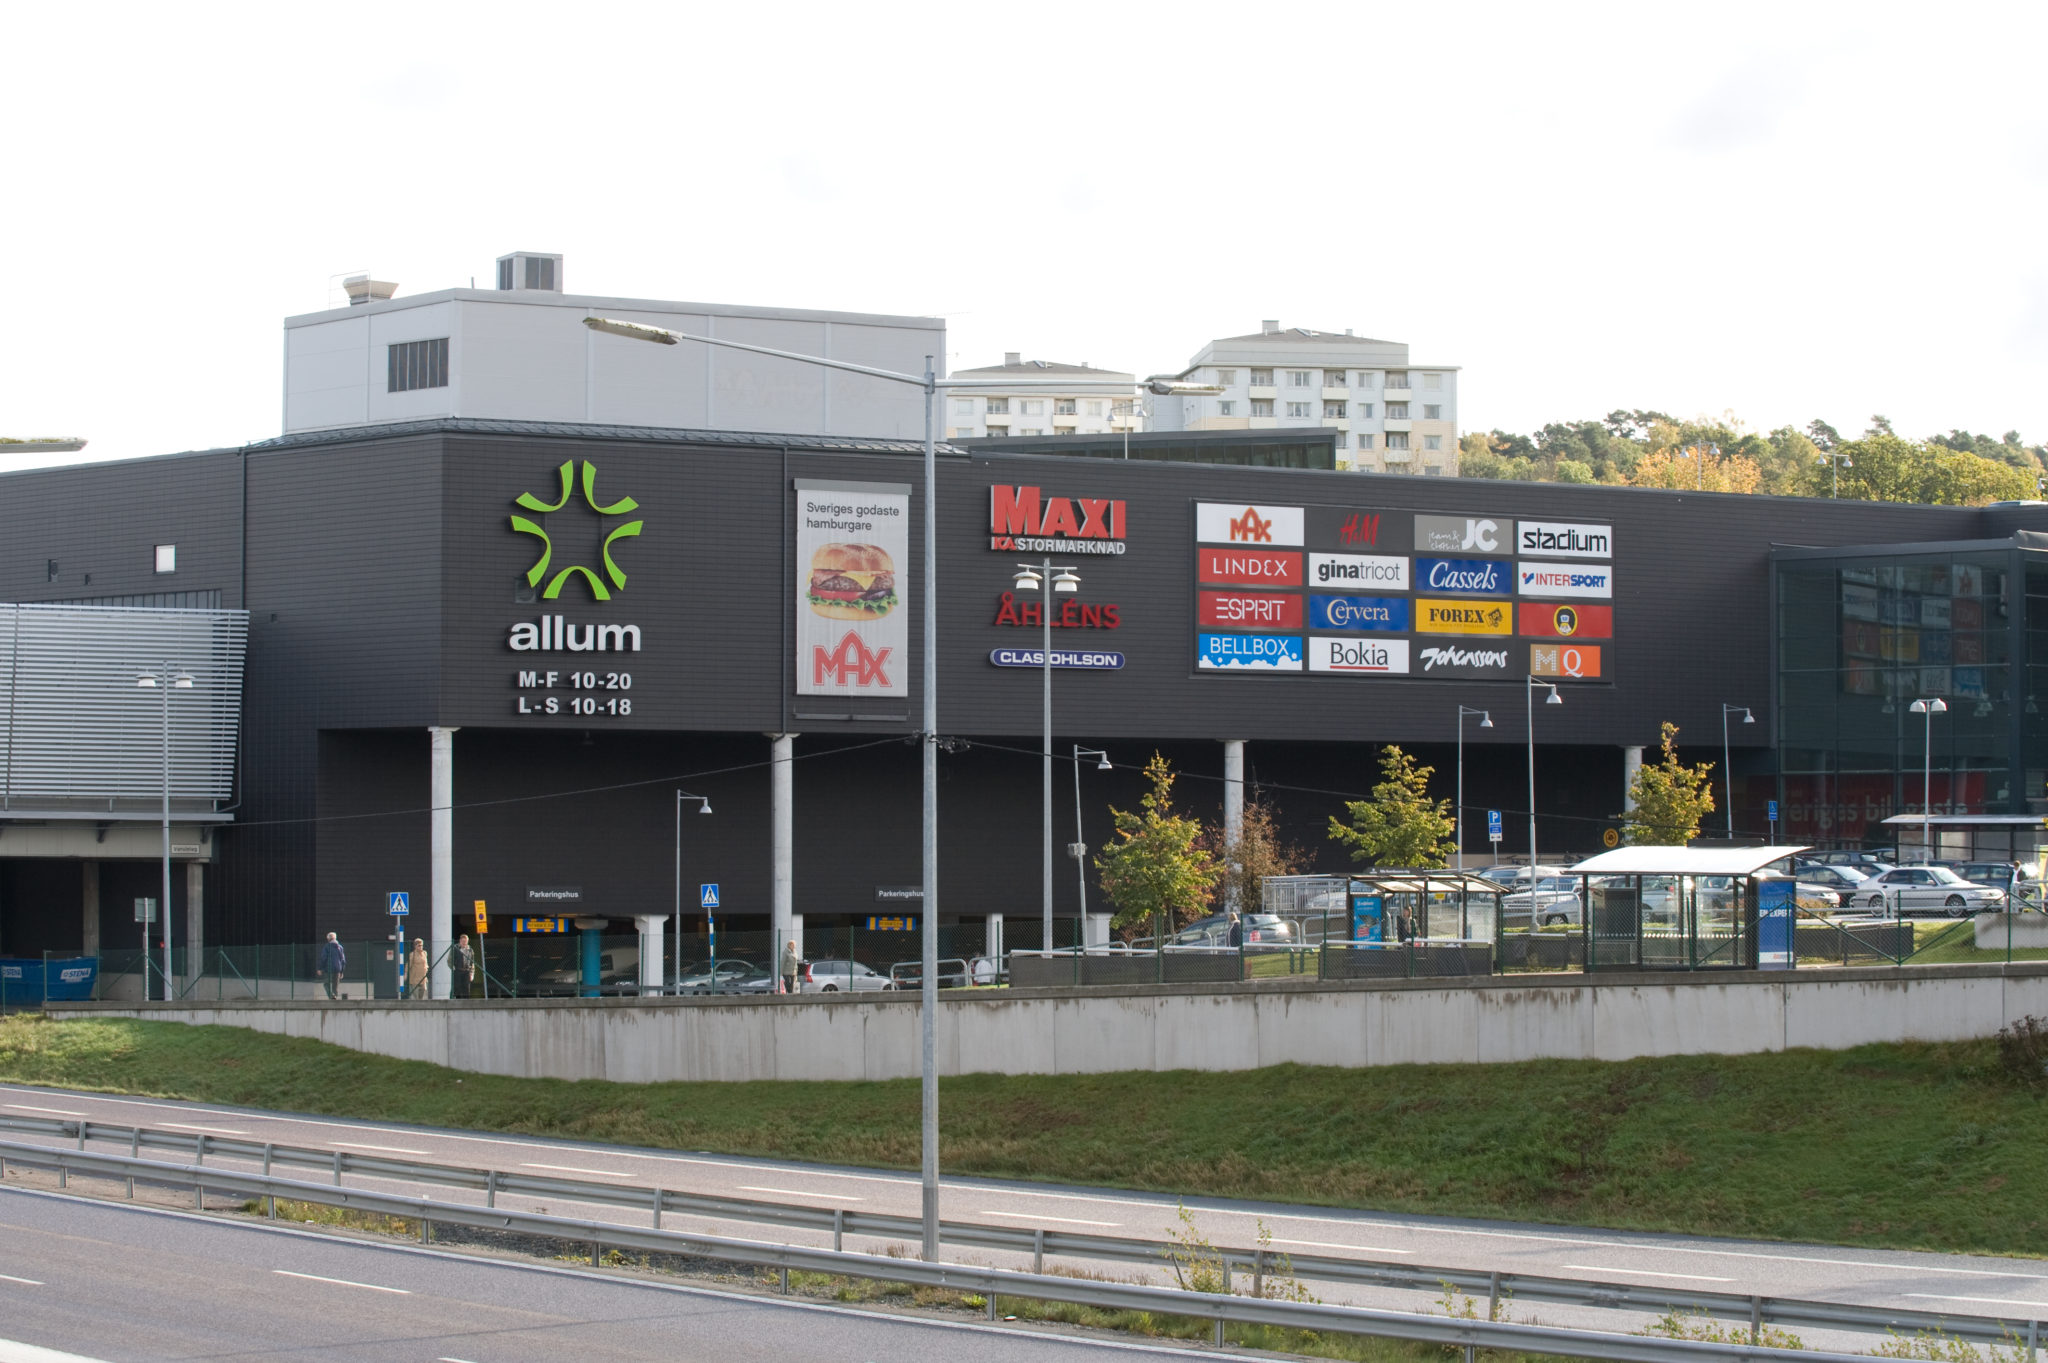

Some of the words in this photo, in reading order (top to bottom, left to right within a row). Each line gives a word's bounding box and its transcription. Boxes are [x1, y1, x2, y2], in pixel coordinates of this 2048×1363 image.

[806, 502, 853, 516] Sveriges
[856, 505, 899, 517] godaste
[991, 485, 1126, 539] MAXI
[806, 518, 872, 532] hamburgare
[1229, 506, 1272, 543] MAX
[1339, 514, 1380, 546] H&M
[991, 536, 1017, 551] ICA
[1016, 538, 1126, 555] STORMARKNAD
[1461, 519, 1498, 552] JC
[1523, 527, 1608, 552] stadium
[1213, 557, 1288, 577] LINDEX
[1429, 562, 1498, 590] Cassels
[1535, 572, 1607, 589] INTERSPORT
[1216, 597, 1286, 621] ESPRIT
[1327, 599, 1390, 626] Cervera
[1429, 608, 1485, 624] FOREX
[509, 614, 642, 652] allum
[1210, 637, 1289, 656] BELLBOX
[1330, 642, 1388, 666] Bokia
[813, 629, 893, 687] MAX
[1000, 651, 1044, 664] CLAS
[1048, 653, 1118, 666] OHLSON
[1419, 646, 1507, 671] Johanssons
[518, 671, 559, 688] M-F
[570, 673, 632, 690] 10-20
[518, 697, 559, 714] L-S
[570, 698, 632, 716] 10-18
[1492, 812, 1499, 823] P
[529, 890, 579, 900] Parkeringshus
[878, 890, 924, 899] Parkeringshus
